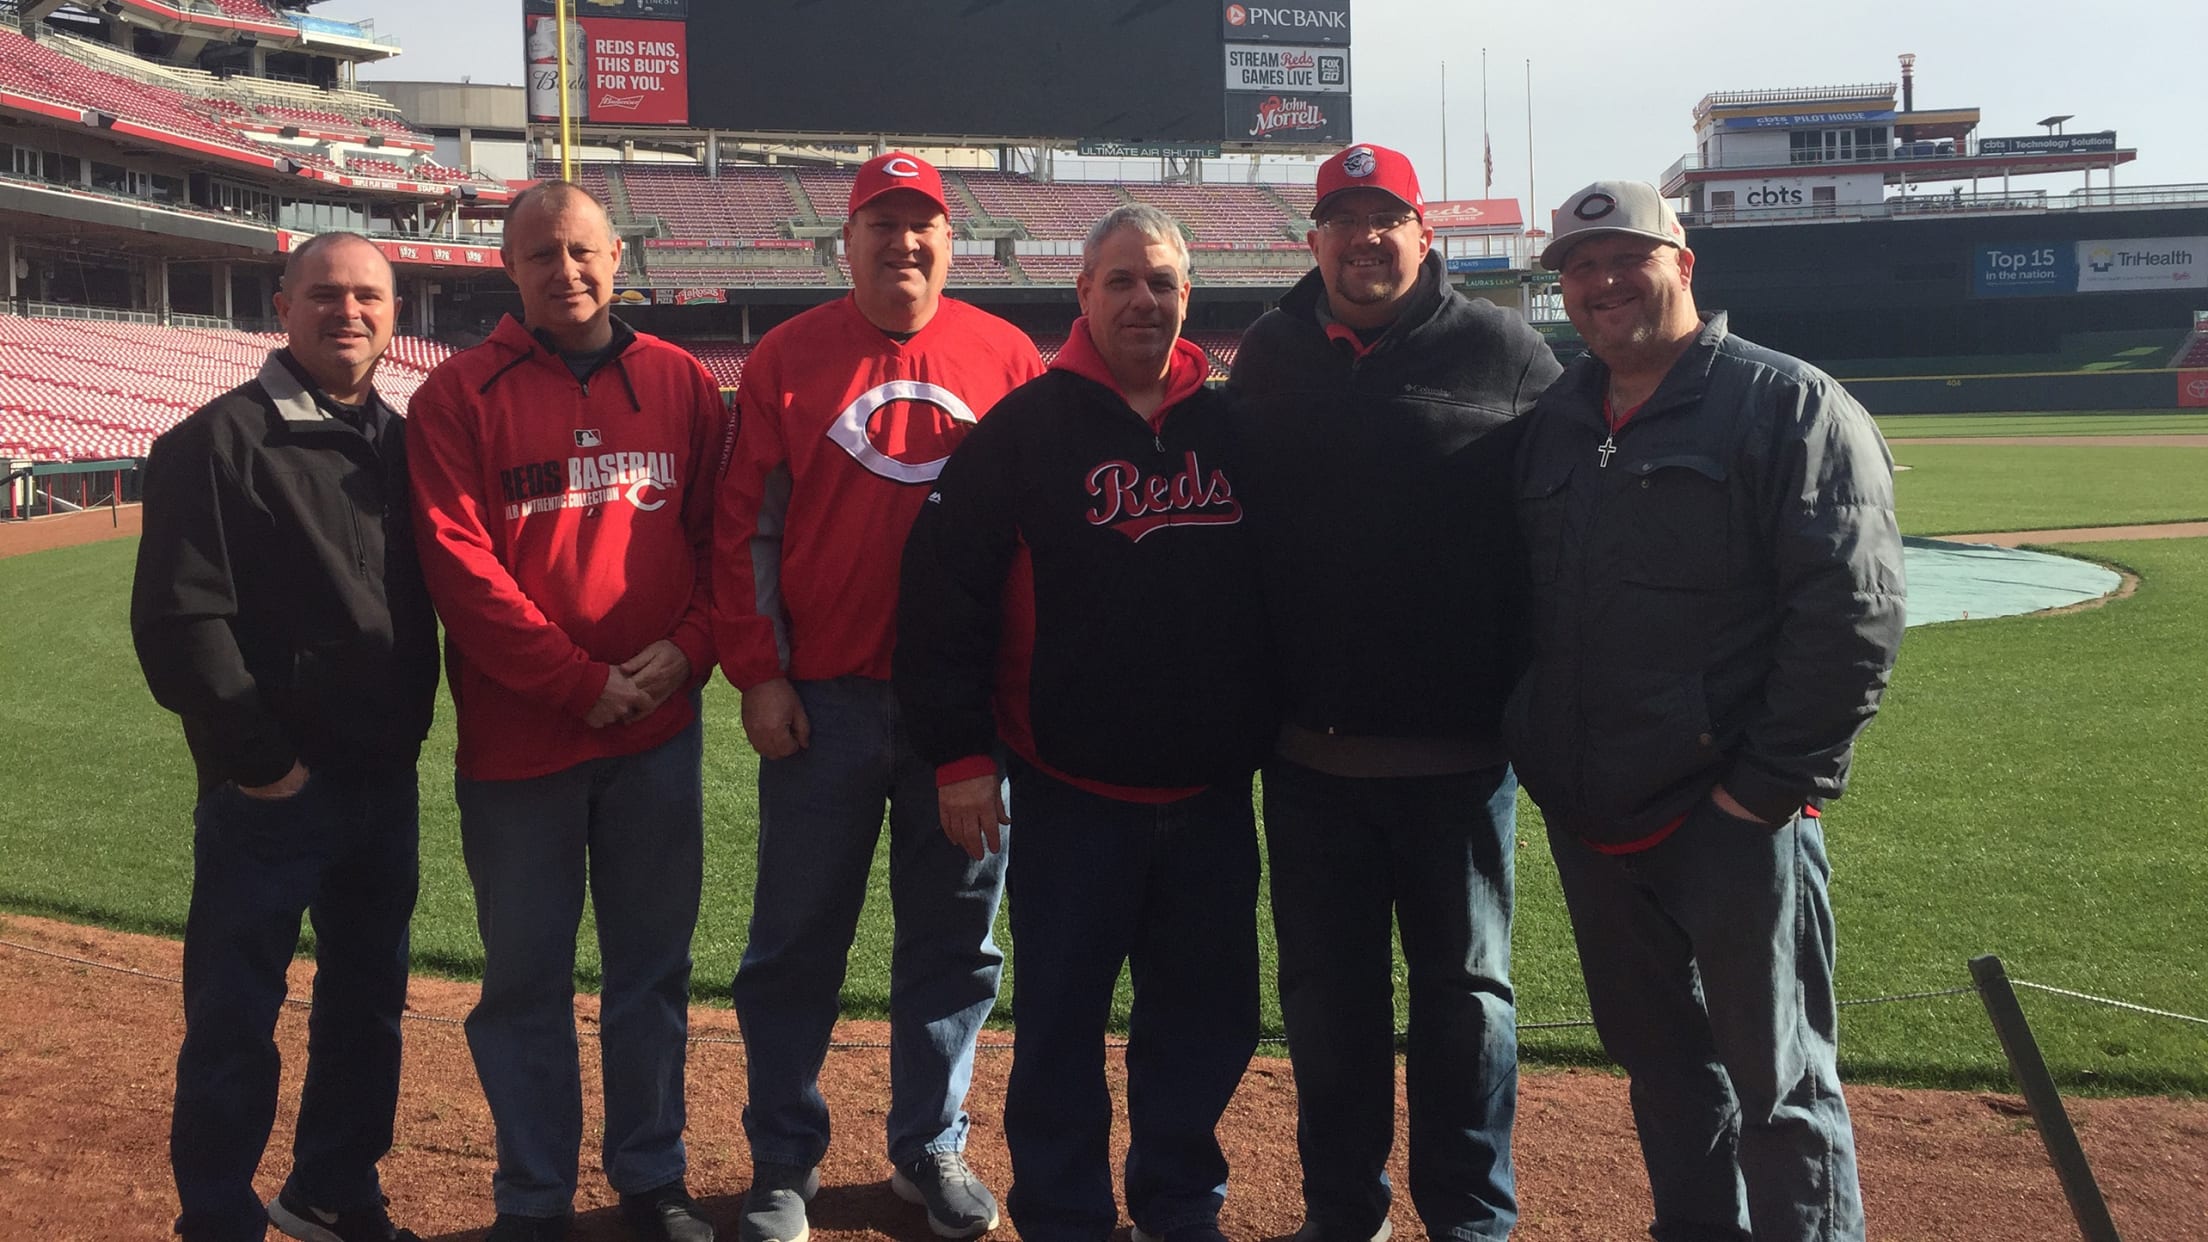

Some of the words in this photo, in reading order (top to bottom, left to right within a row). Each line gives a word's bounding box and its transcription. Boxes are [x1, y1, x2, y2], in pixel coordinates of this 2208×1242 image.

[1249, 7, 1290, 26] PNC
[1292, 9, 1346, 28] BANK
[595, 39, 634, 55] REDS
[638, 41, 680, 59] FANS,
[595, 57, 630, 73] THIS
[634, 59, 680, 75] BUD'S
[1230, 51, 1279, 67] STREAM
[1280, 50, 1315, 70] Reds
[1321, 58, 1340, 69] FOX
[596, 74, 626, 90] FOR
[629, 76, 665, 92] YOU.
[1242, 69, 1284, 85] GAMES
[1287, 70, 1312, 86] LIVE
[1322, 72, 1340, 82] GO
[1277, 97, 1307, 112] John
[1249, 106, 1328, 135] Morrell
[1793, 114, 1825, 123] PILOT
[1828, 112, 1866, 121] HOUSE
[1081, 147, 1139, 156] ULTIMATE
[1141, 148, 1160, 157] AIR
[1162, 148, 1216, 158] SHUTTLE
[2016, 139, 2070, 150] Technology
[2071, 137, 2113, 147] Solutions
[1747, 185, 1803, 207] cbts
[1987, 251, 2026, 270] Top
[2031, 249, 2055, 267] 15
[2118, 250, 2193, 267] TriHealth
[1986, 271, 1997, 280] in
[1999, 270, 2017, 281] the
[2019, 270, 2057, 280] nation.
[501, 461, 562, 500] REDS
[568, 452, 677, 491] BASEBALL
[521, 494, 567, 517] AUTHENTIC
[568, 487, 619, 509] COLLECTION
[1085, 450, 1243, 543] Reds
